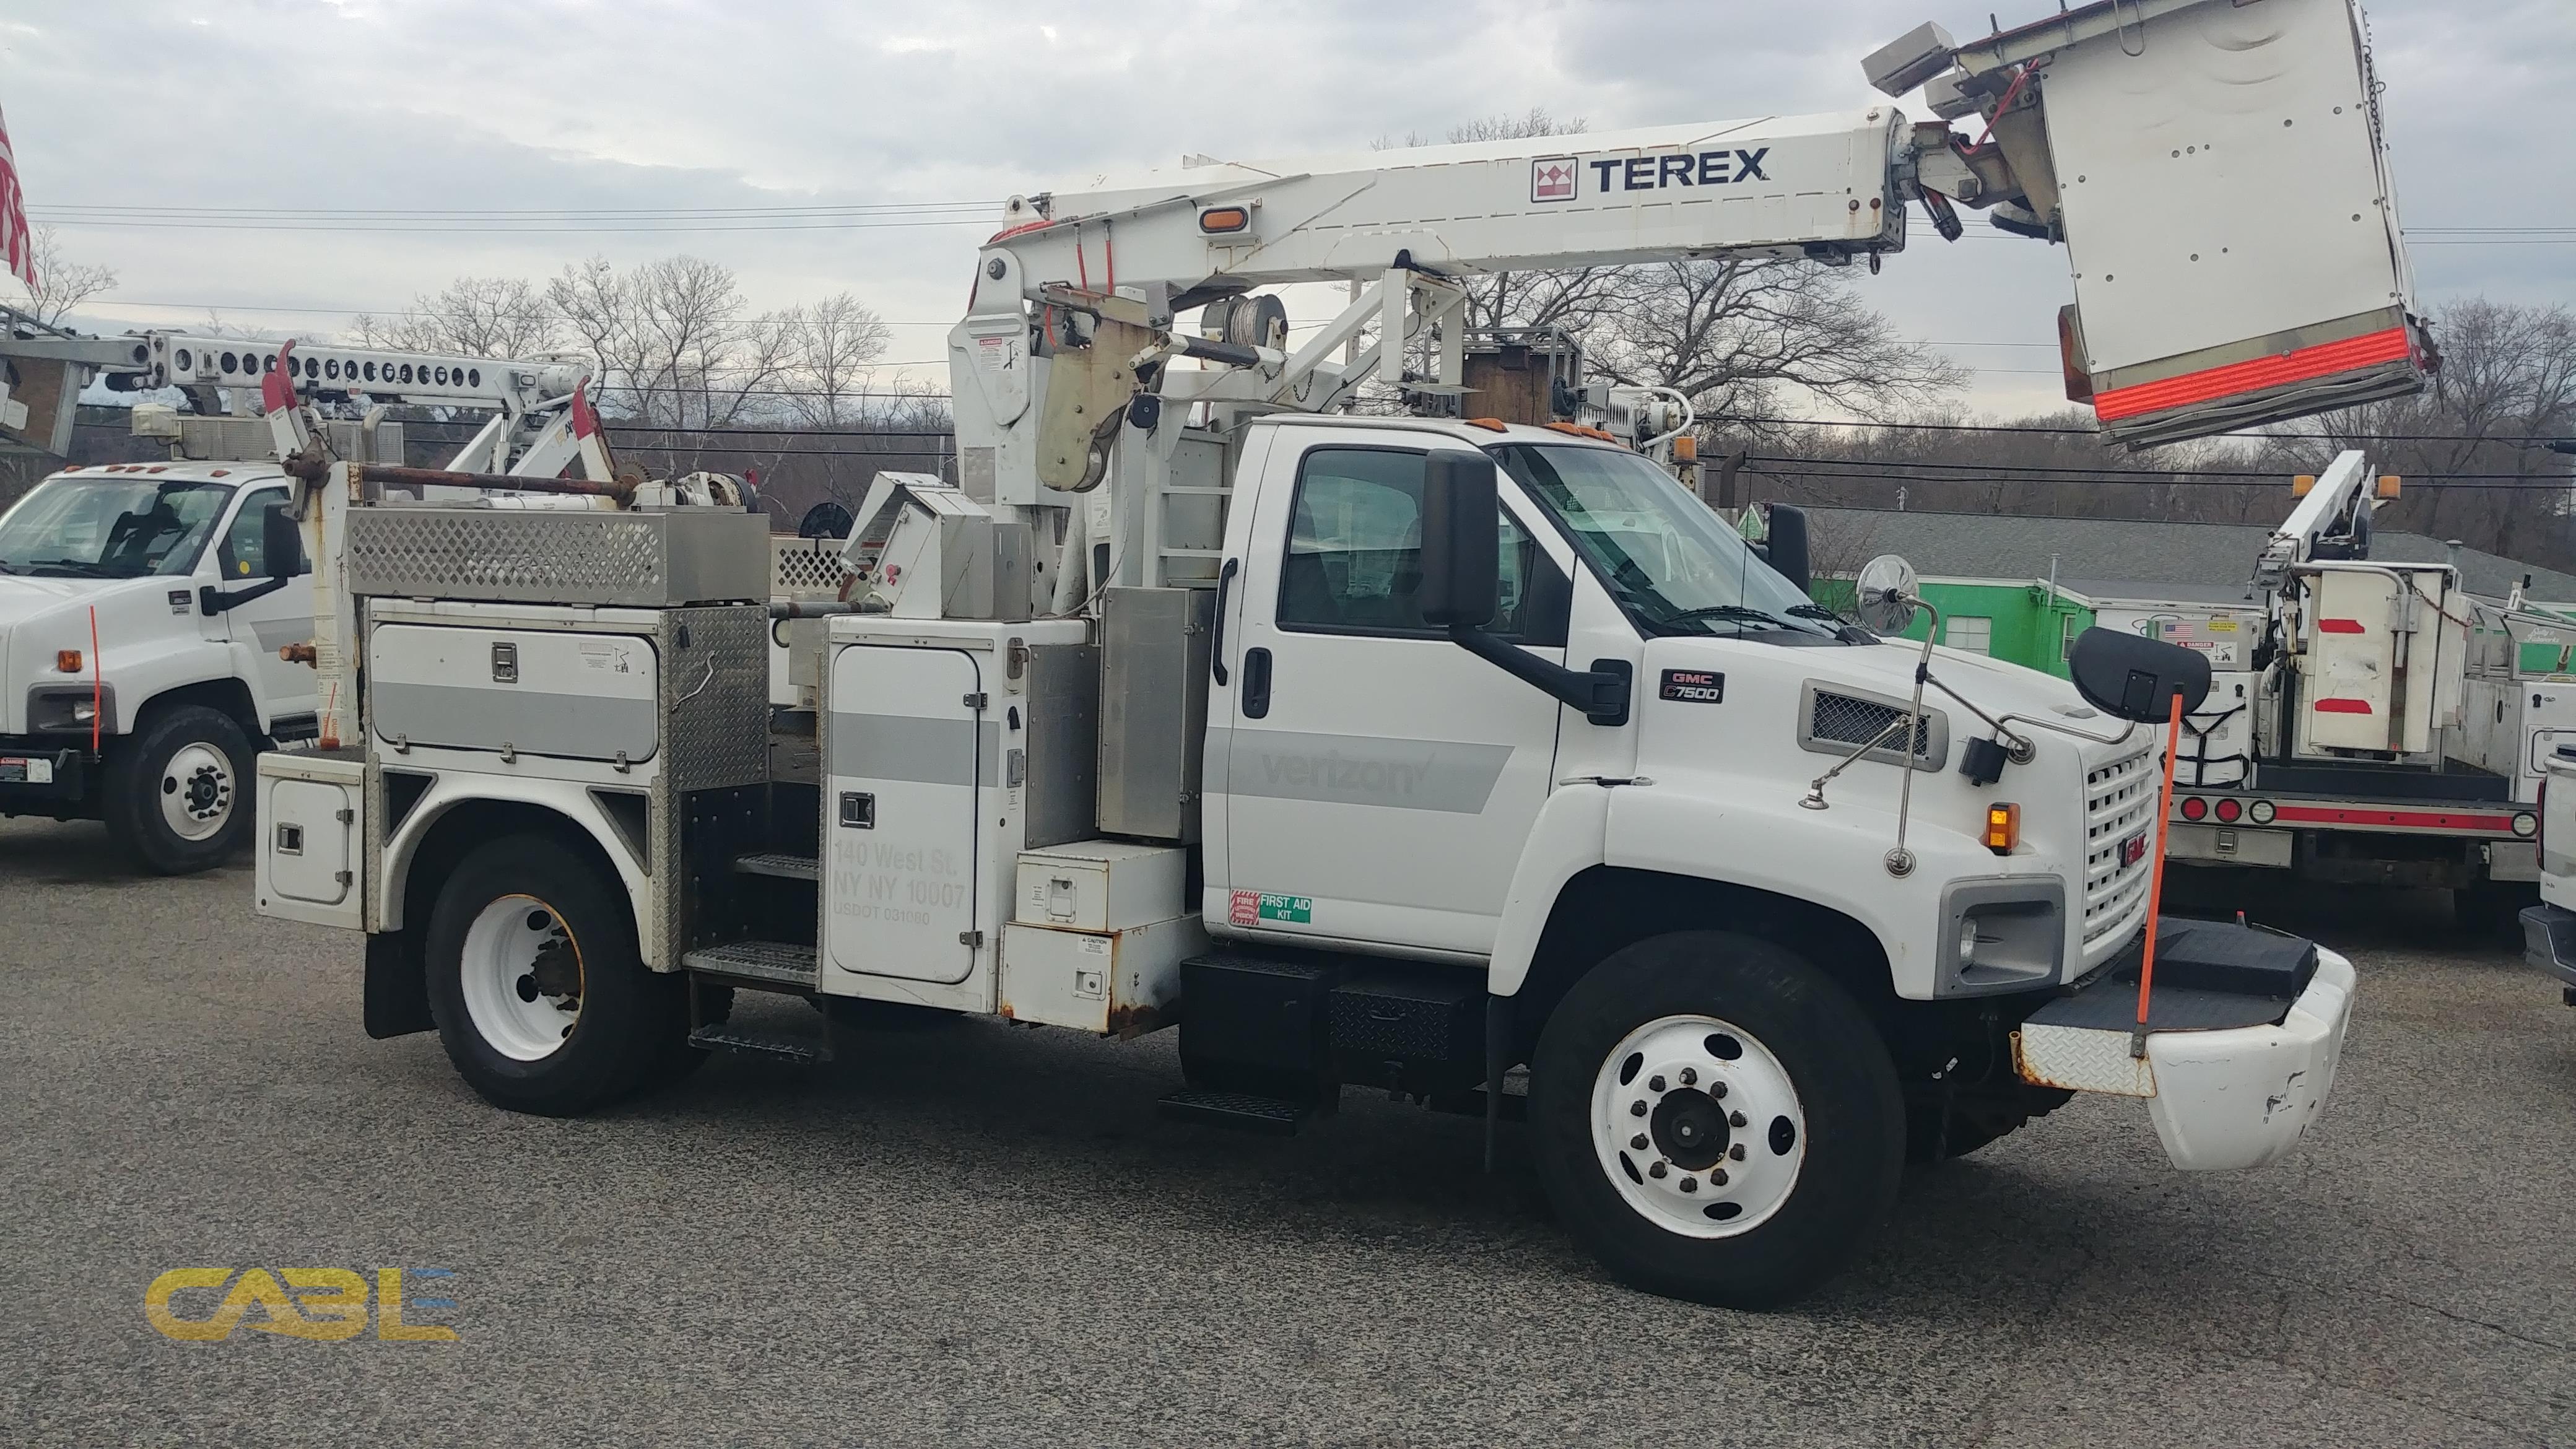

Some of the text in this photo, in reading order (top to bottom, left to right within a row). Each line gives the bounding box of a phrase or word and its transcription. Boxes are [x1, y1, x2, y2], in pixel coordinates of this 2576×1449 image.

[1590, 147, 1771, 193] TEREX
[1673, 673, 1713, 685] GMC
[1663, 685, 1720, 700] C7500
[1261, 749, 1414, 795] verizon
[835, 839, 957, 876] 140 West St.
[833, 870, 966, 909] NY NY 10007
[833, 901, 880, 920] USDOT
[1237, 897, 1255, 906] FIRE
[1261, 894, 1312, 911] FIRST AID
[1277, 909, 1292, 920] KIT
